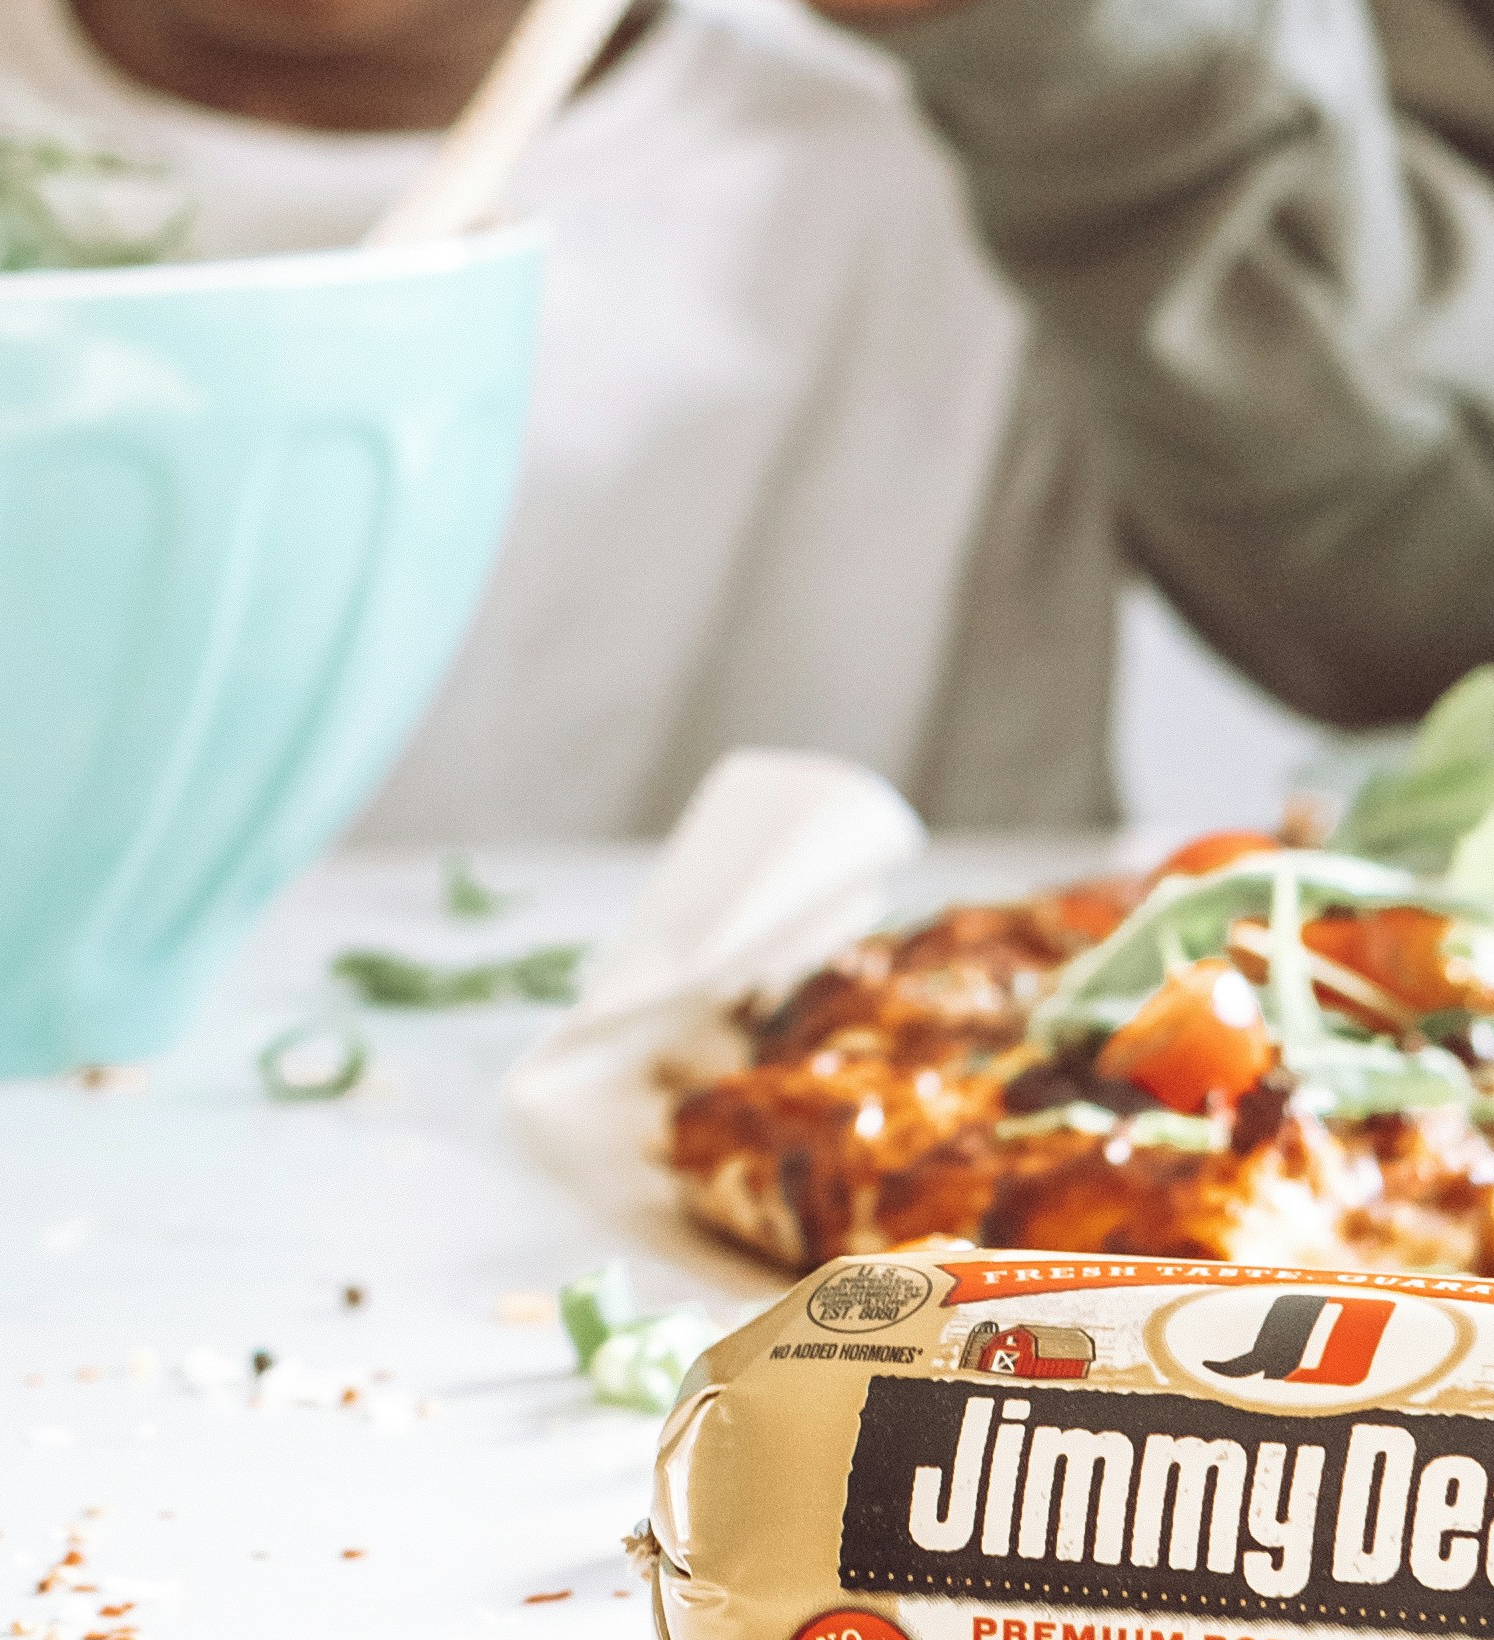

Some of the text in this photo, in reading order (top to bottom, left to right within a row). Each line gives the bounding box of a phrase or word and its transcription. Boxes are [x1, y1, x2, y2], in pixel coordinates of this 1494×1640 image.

[982, 1266, 1137, 1285] FRESH
[769, 1343, 792, 1360] NO
[791, 1342, 838, 1360] ADDED
[908, 1396, 1326, 1599] Jimmy
